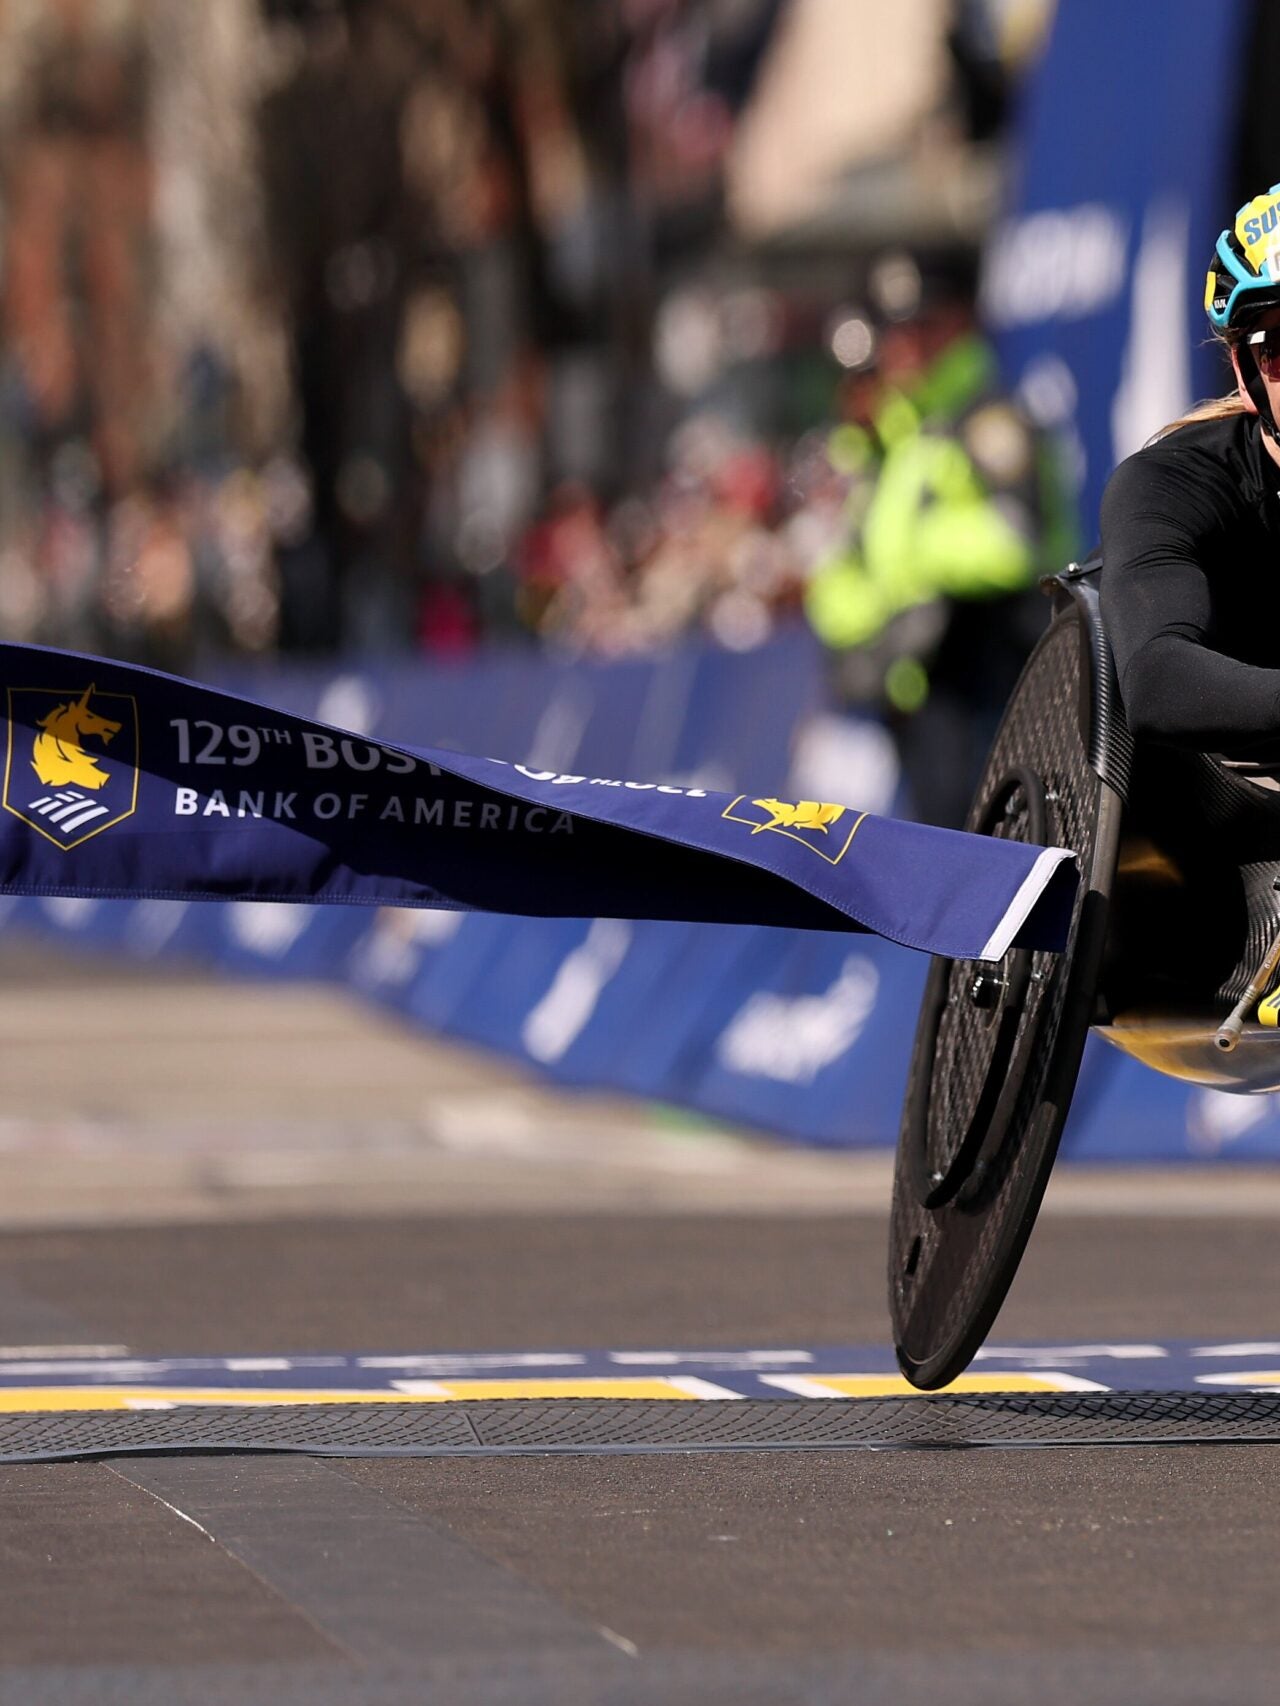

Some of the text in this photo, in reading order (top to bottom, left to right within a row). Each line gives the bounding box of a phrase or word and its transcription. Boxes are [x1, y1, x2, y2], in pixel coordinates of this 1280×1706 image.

[169, 718, 292, 765] 129TH
[174, 787, 575, 835] BANK OF AMERICA
